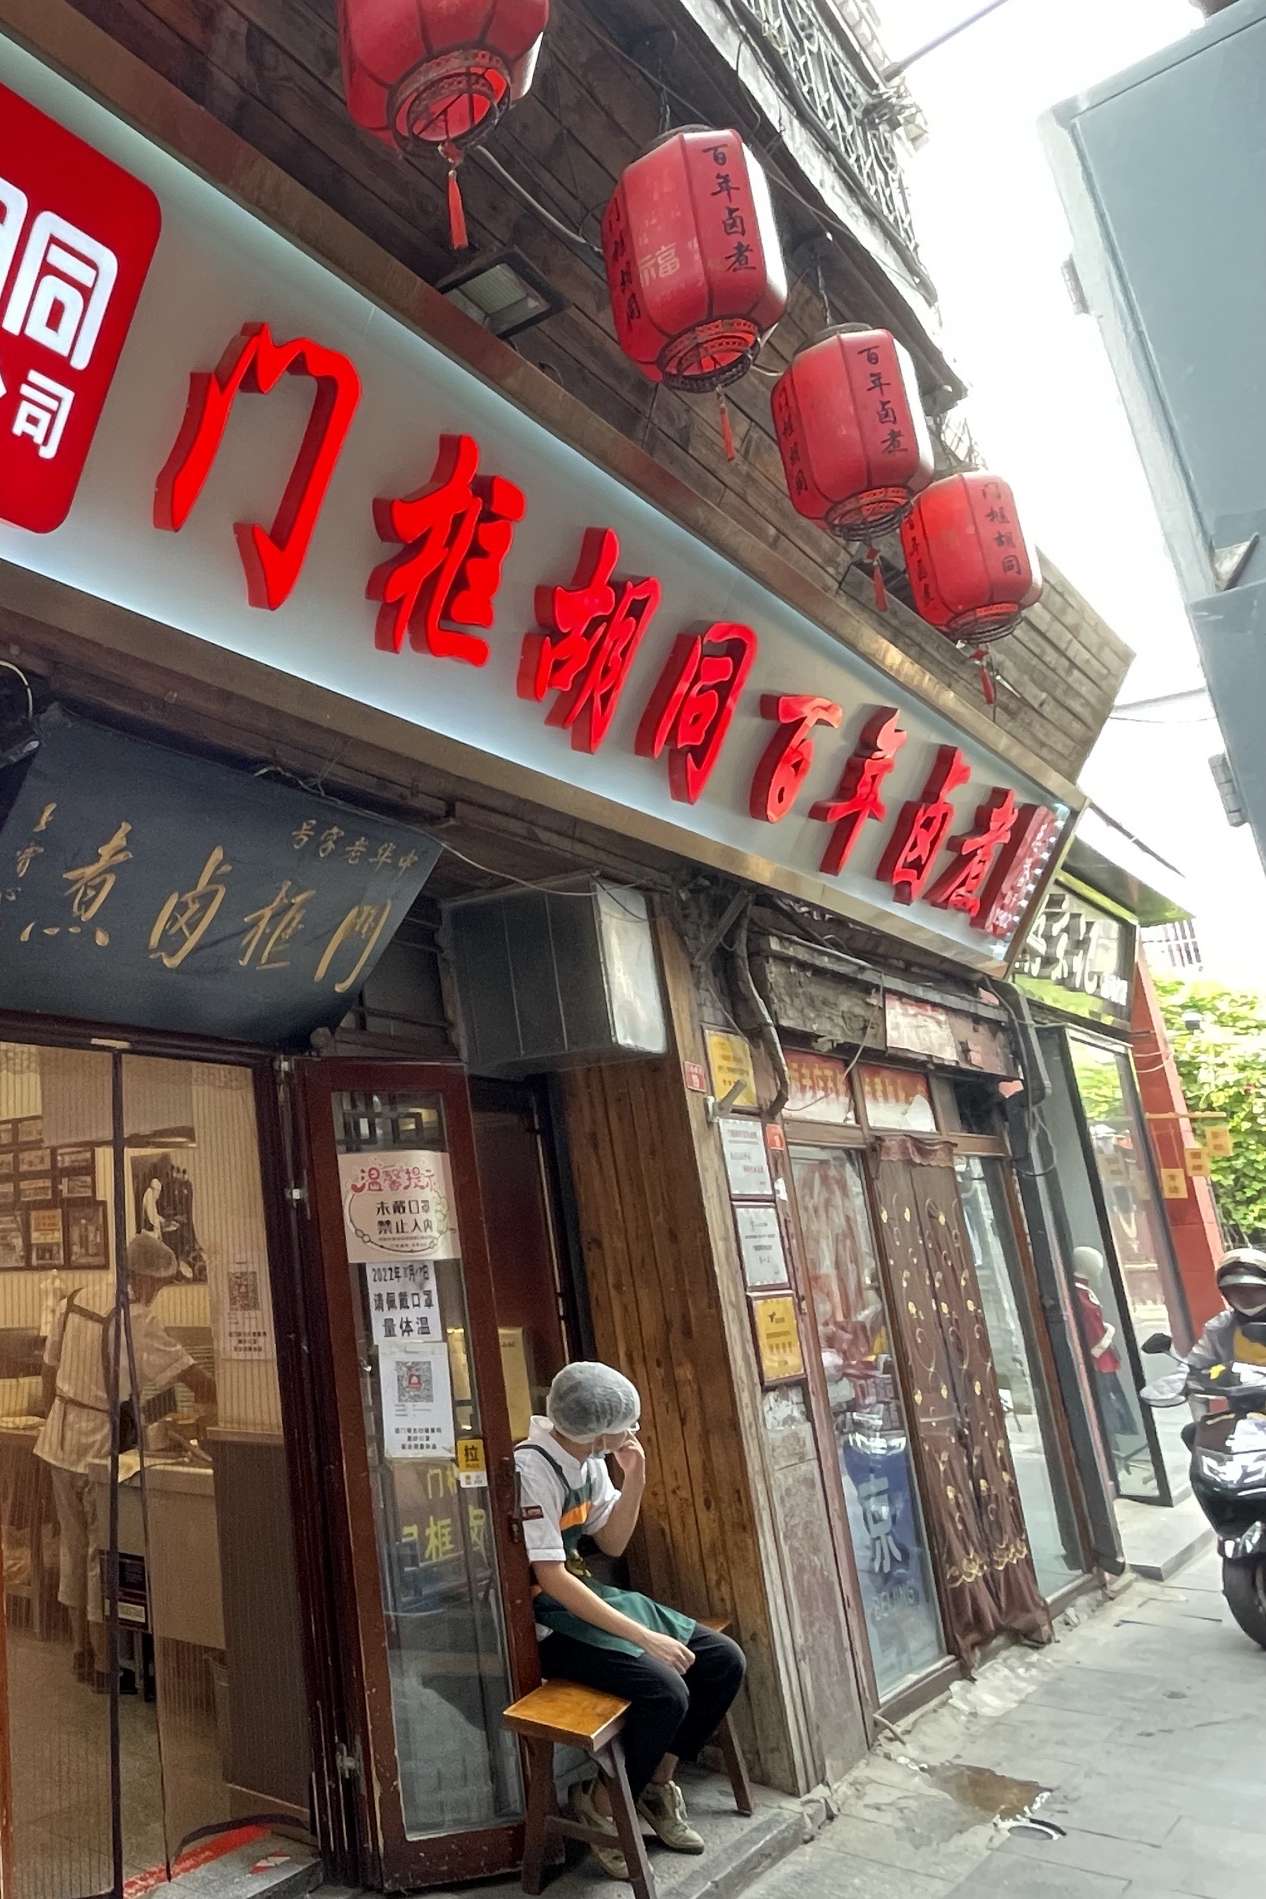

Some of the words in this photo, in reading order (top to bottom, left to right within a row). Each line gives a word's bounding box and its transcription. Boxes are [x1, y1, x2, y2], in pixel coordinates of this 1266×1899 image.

[702, 143, 756, 273] 百年卤煮
[858, 345, 908, 453] 百年卤煮
[153, 322, 1019, 917] 门框胡同百年卤煮
[351, 1165, 435, 1192] 温馨提示
[376, 1200, 431, 1216] 未戴口罩
[378, 1219, 434, 1235] 禁止入内
[373, 1290, 434, 1312] 请佩戴口罩
[383, 1316, 431, 1337] 量体温
[464, 1444, 480, 1461] 拉
